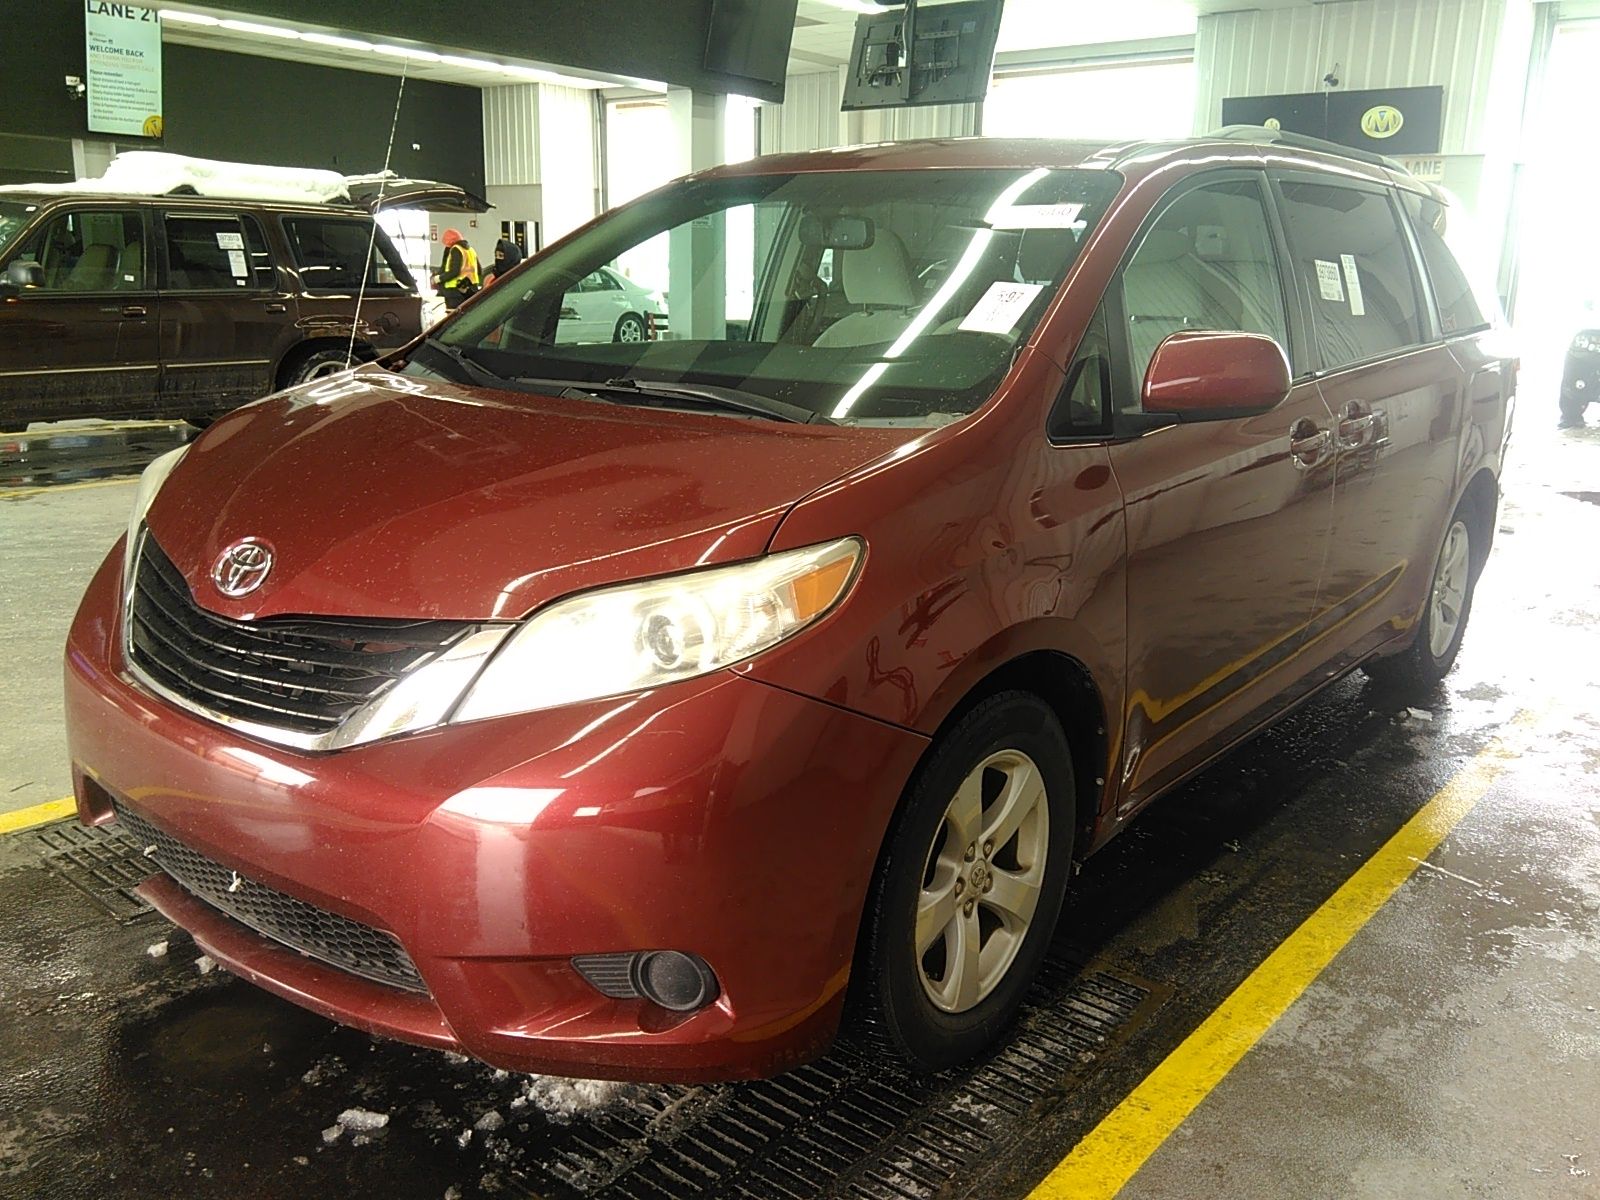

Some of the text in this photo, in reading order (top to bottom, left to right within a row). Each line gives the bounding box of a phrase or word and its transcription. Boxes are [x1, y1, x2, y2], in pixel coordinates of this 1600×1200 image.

[87, 0, 158, 23] LANE 21
[89, 44, 144, 58] WELCOME BACK
